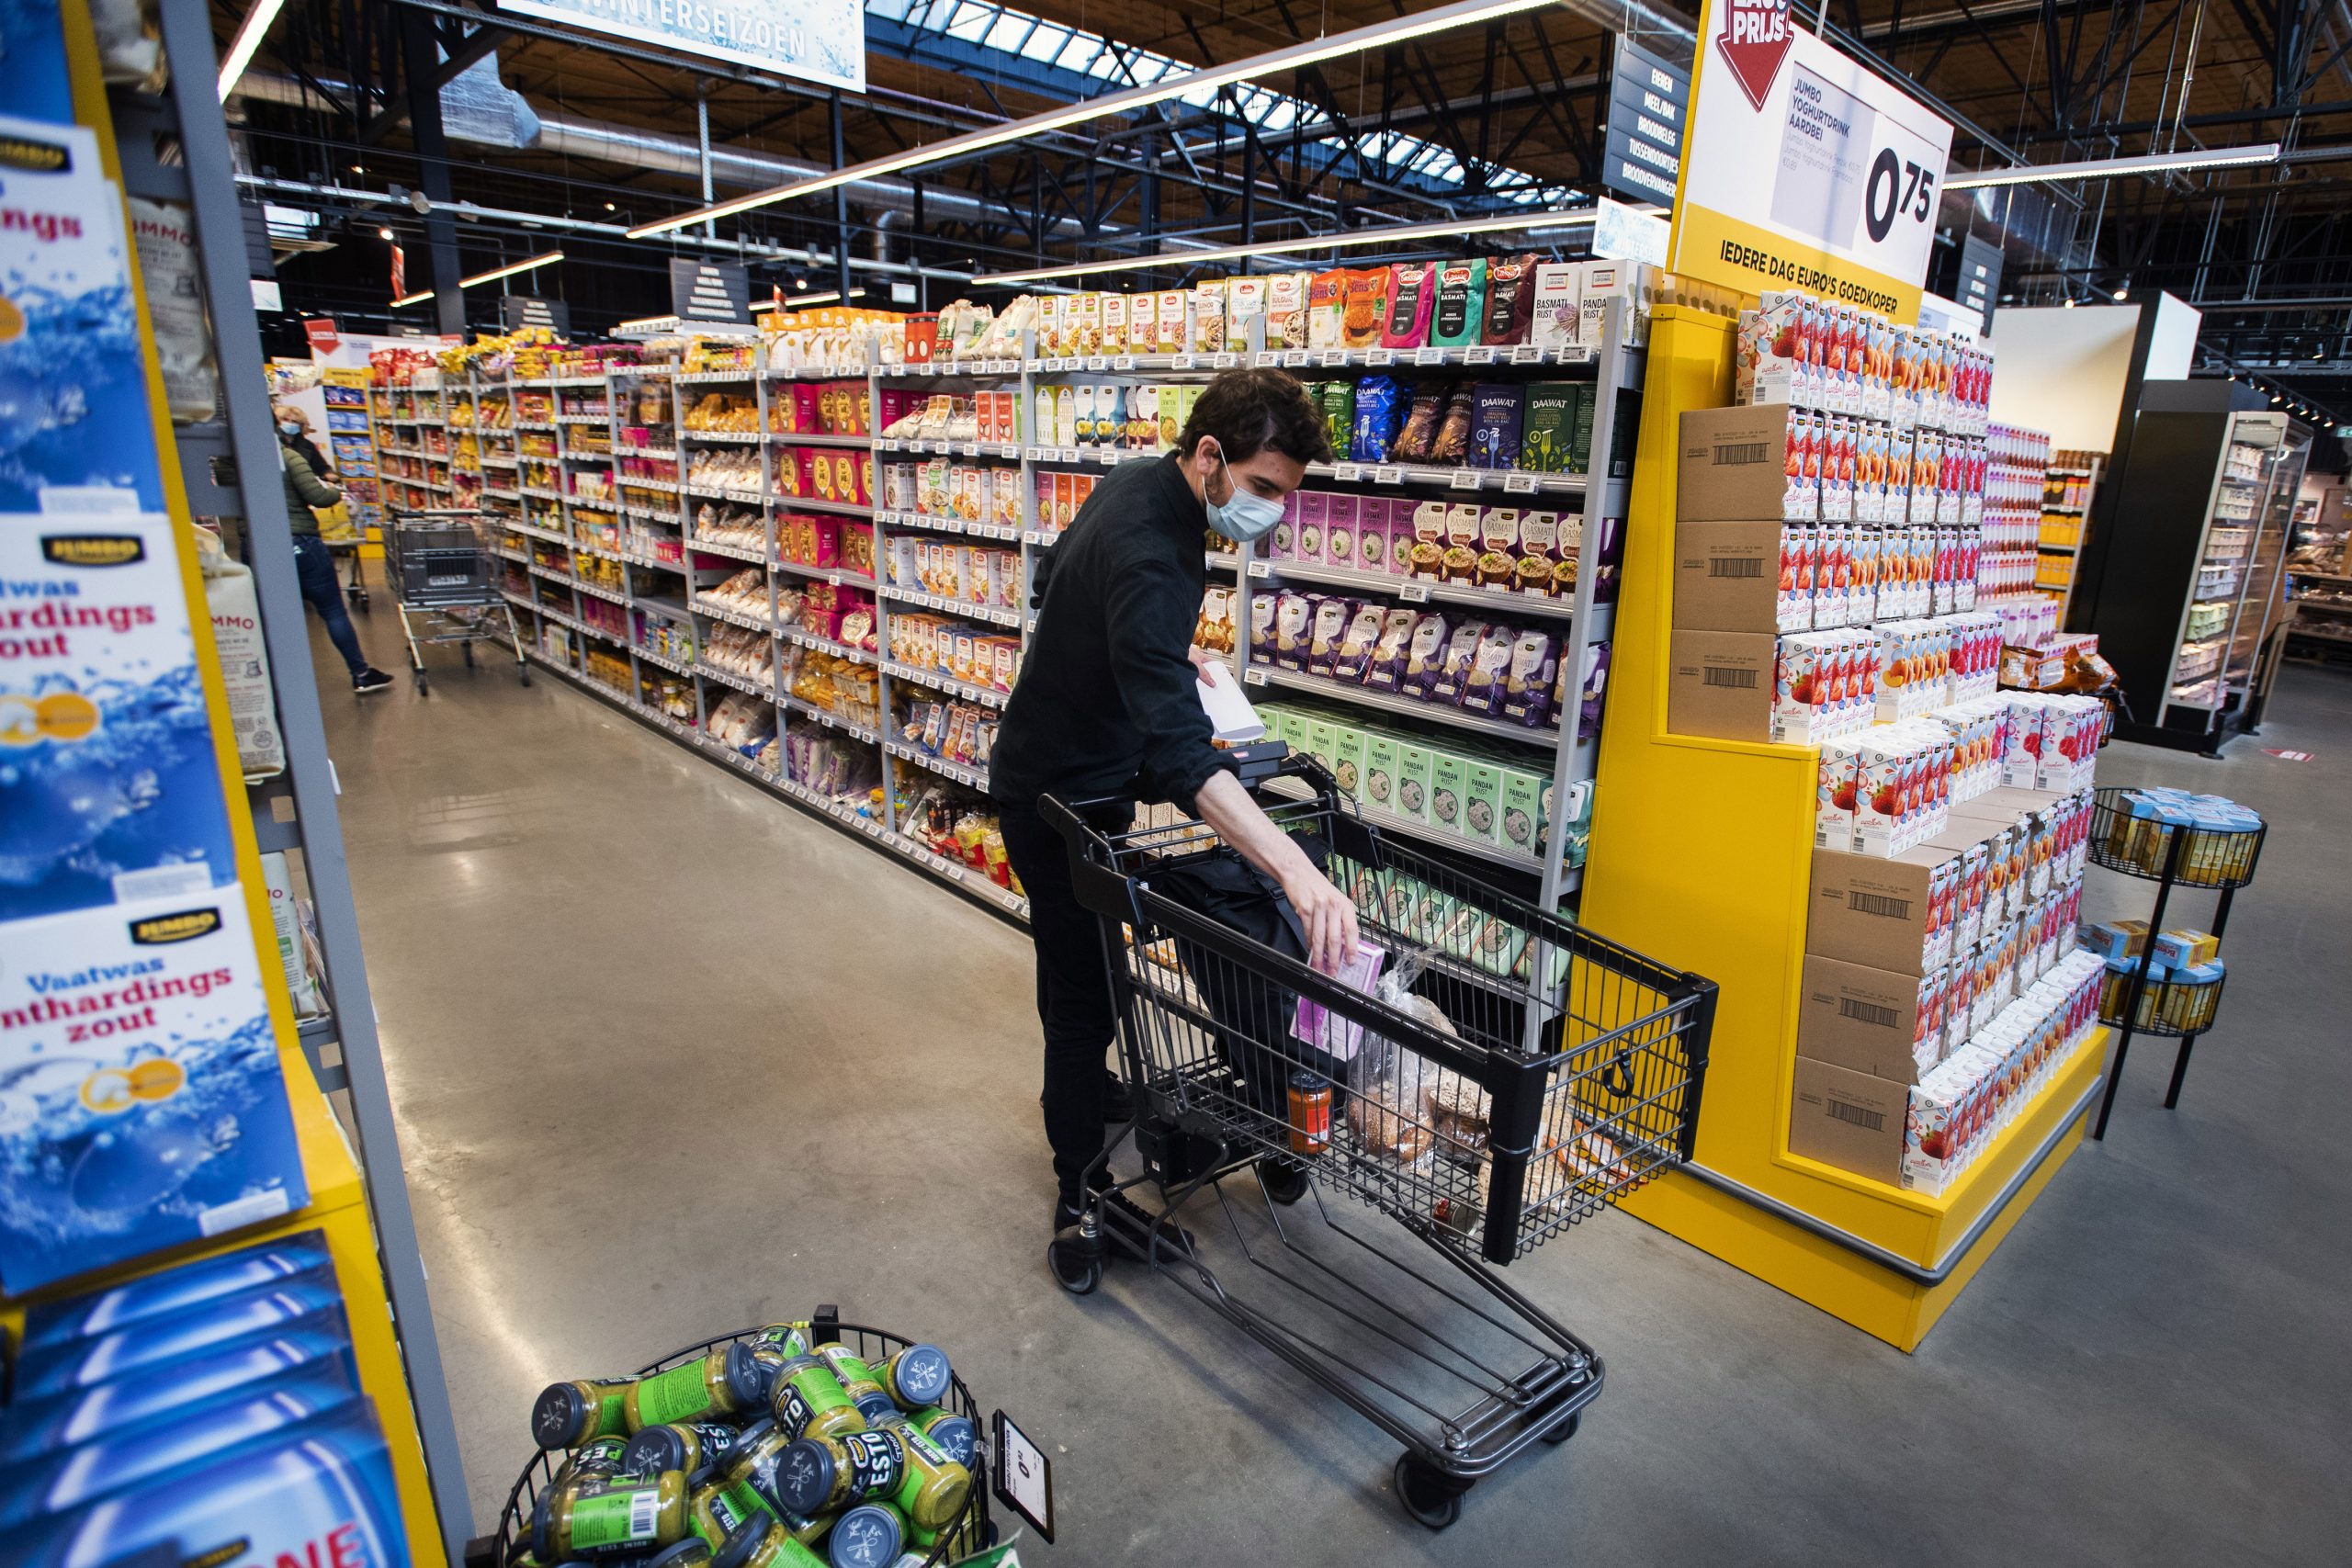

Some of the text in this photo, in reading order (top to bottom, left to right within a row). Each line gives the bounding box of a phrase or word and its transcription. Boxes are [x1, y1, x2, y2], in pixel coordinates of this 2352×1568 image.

[1733, 11, 1787, 45] PRIJS
[1651, 68, 1674, 94] EIEREN
[1794, 78, 1822, 104] JUMBO
[1644, 91, 1676, 121] MEEL/BAK
[1792, 95, 1850, 139] YOGHURTDRINK
[1637, 115, 1677, 147] BROODBELEG
[1789, 113, 1824, 141] AARDBEI
[1629, 137, 1679, 175] TUSSENDOORTJES
[1622, 162, 1678, 199] BROODVERVANGER
[1866, 147, 1935, 243] 0 75
[1720, 239, 1898, 316] IEDERE DAG EURO'S GOEDKOPER
[1536, 299, 1567, 310] BASMATI
[1583, 299, 1606, 310] PANDA
[1536, 310, 1553, 319] RIJST
[1583, 310, 1600, 319] RIJST
[1356, 388, 1386, 397] DAAWAT
[1481, 398, 1517, 409] DAAWAT
[1532, 399, 1568, 410] DAAWAT
[1395, 514, 1412, 523] BASMA
[1418, 513, 1443, 526] BASMATI
[1449, 517, 1476, 529] BASMATI
[1485, 521, 1514, 533] BASMATI
[1523, 525, 1554, 536] BASMATI
[1562, 527, 1582, 539] BASM
[0, 579, 80, 598] was
[0, 602, 156, 633] rdings
[0, 632, 70, 659] out
[1285, 728, 1302, 738] PANDAN
[1312, 735, 1329, 746] PANDAN
[1340, 742, 1359, 752] PANDAN
[1372, 750, 1392, 762] PANDAN
[1403, 760, 1424, 772] PANDAN
[1437, 769, 1459, 781] PANDAN
[1471, 778, 1493, 791] PANDAN
[1509, 788, 1532, 801] PANDAN
[26, 957, 166, 994] Vaatwas
[0, 967, 233, 1030] nthardings
[67, 1007, 158, 1043] zout
[577, 1446, 623, 1465] PES
